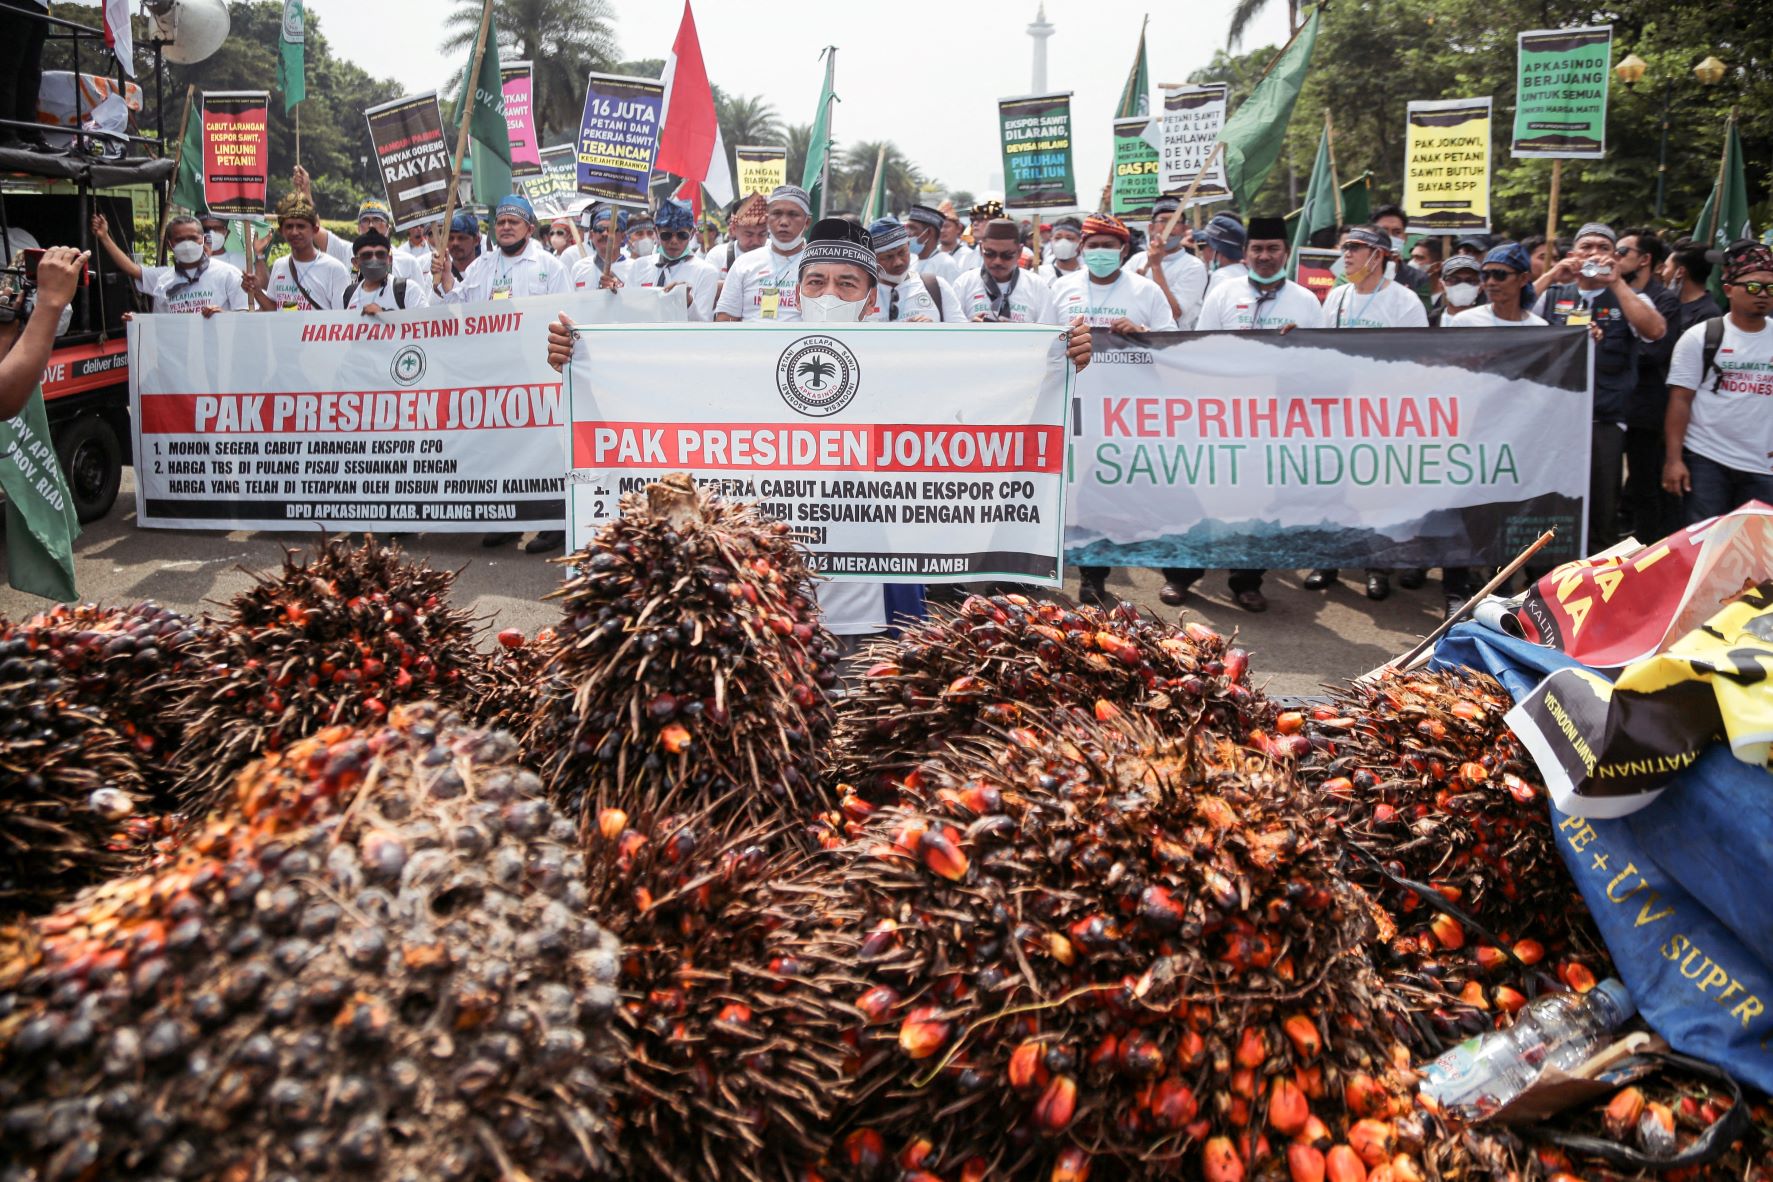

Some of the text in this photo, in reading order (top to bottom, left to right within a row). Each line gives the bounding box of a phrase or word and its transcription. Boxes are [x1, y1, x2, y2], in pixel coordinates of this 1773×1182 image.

[1523, 58, 1604, 73] APKASINDO
[1523, 72, 1603, 88] BERJUANG
[1521, 89, 1602, 102] UNTUK SEMUA
[591, 98, 656, 123] 16 JUTA
[1164, 111, 1221, 126] PETANI SAWIT
[206, 122, 265, 132] CABUT LARANGAN
[590, 118, 651, 135] PETANI DAN
[1004, 115, 1069, 130] EKSPOR SAWIT
[1165, 120, 1218, 134] ADALAH
[210, 133, 261, 143] EKSPOR SAWIT,
[583, 127, 655, 146] PEKERJA SAWIT
[1004, 125, 1069, 141] DILARANG,
[215, 144, 256, 154] LINDUNGI
[581, 140, 650, 161] TERANCAM
[1006, 140, 1069, 154] DEVISA HILANG
[1414, 136, 1483, 149] PAK JOKOWI,
[381, 140, 444, 167] MINYAK GORENG
[1165, 145, 1212, 158] DEVIS
[1411, 152, 1485, 163] ANAK PETANI
[384, 151, 446, 183] RAKYAT
[1011, 153, 1066, 169] PULUHAN
[744, 168, 780, 176] JANGAN
[1012, 166, 1066, 180] TRILIUN
[1117, 163, 1143, 176] GAS
[1410, 166, 1485, 177] SAWIT BUTUH
[744, 177, 780, 185] BIARKAN
[1417, 181, 1478, 191] BAYAR SPP
[842, 248, 868, 266] PETANI
[301, 312, 525, 342] HARAPAN PETANI SAWIT
[803, 338, 833, 348] KELAPA
[780, 349, 795, 372] PETANI
[841, 350, 856, 372] SAWIT
[1091, 351, 1155, 366] INDONESIA
[83, 358, 111, 376] deliver
[1721, 371, 1754, 381] PETANI
[798, 384, 838, 399] APKASINDO
[1720, 380, 1773, 397] NDONES
[823, 382, 856, 413] INDONESIA
[195, 394, 266, 433] PAK
[272, 390, 440, 433] PRESIDEN
[1103, 397, 1459, 439] KEPRIHATINAN
[154, 439, 443, 456] 1. MOHON SEGERA CABUT LARANGAN EKSPOR CPO
[594, 427, 669, 465] PAK
[677, 428, 869, 468] PRESIDEN
[876, 430, 1024, 467] JOKOWI
[154, 459, 458, 475] 2. HARGA TBS DI PULANG PISAU SESUAIKAN DENGAN
[1095, 442, 1520, 485] SAWIT INDONESIA
[7, 440, 64, 511] PROV. RIAU
[169, 480, 206, 495] HARGA
[210, 480, 240, 494] YANG
[245, 480, 279, 494] TELAH
[283, 480, 297, 494] DI
[301, 480, 357, 495] TETAPKAN
[361, 480, 390, 494] OLEH
[394, 480, 439, 494] DISBUN
[443, 479, 497, 494] PROVINSI
[760, 480, 817, 498] CABUT
[820, 480, 917, 500] LARANGAN
[922, 481, 994, 500] EKSPOR
[998, 480, 1035, 500] CPO
[286, 503, 517, 520] DPD APKASINDO KAB. PULANG PISAU
[594, 500, 610, 519] 2.
[797, 503, 897, 523] SESUAIKAN
[901, 503, 975, 524] DENGAN
[979, 504, 1041, 524] HARGA
[832, 556, 919, 573] MERANGIN
[921, 557, 970, 573] JAMBI
[1544, 689, 1599, 770] SAWIT INDONESIA
[1605, 861, 1677, 929] UV
